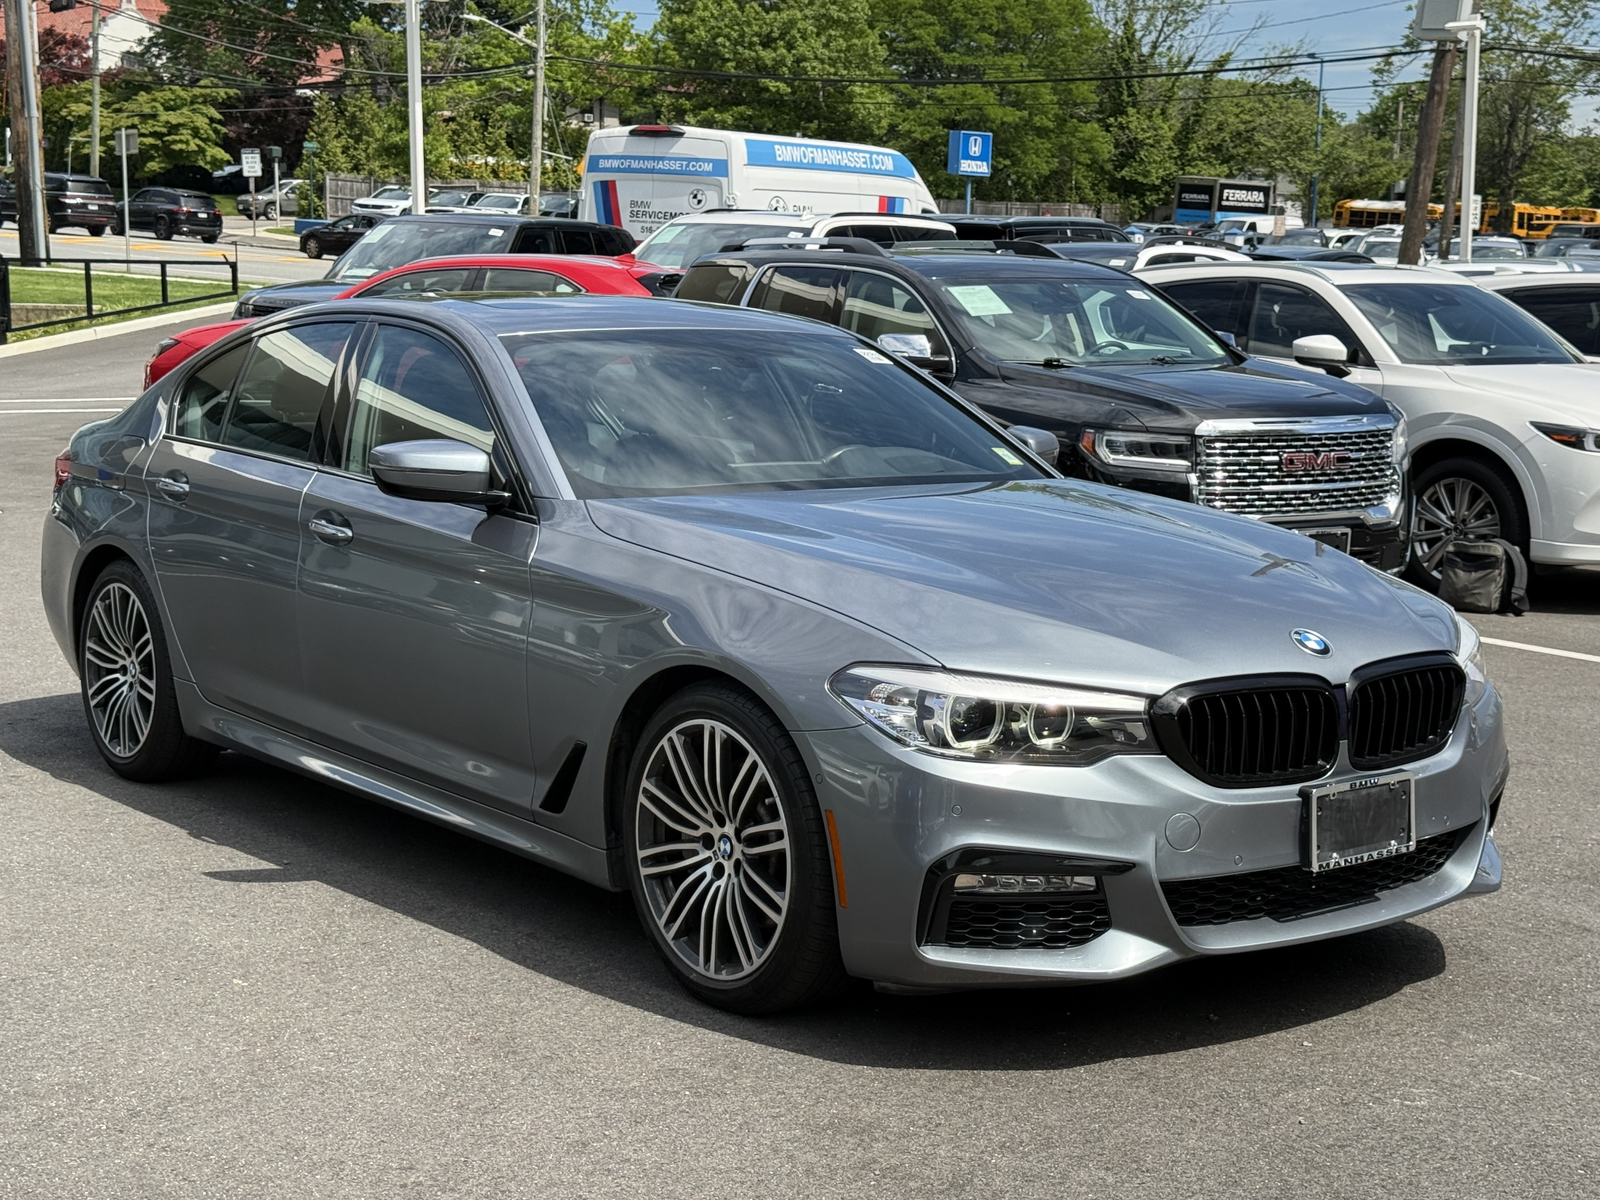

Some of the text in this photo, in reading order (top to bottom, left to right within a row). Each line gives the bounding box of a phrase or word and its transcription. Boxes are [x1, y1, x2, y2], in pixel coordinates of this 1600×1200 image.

[774, 145, 894, 171] BMWOFMANHASSET.COM
[598, 159, 713, 172] BMWOFMANHASSET.COM
[960, 160, 989, 173] HONDA
[1222, 189, 1265, 203] FERRARA
[629, 200, 652, 210] BMW
[1282, 451, 1351, 471] GMC
[1349, 778, 1380, 790] BMW
[1318, 845, 1412, 872] MANHASSET
